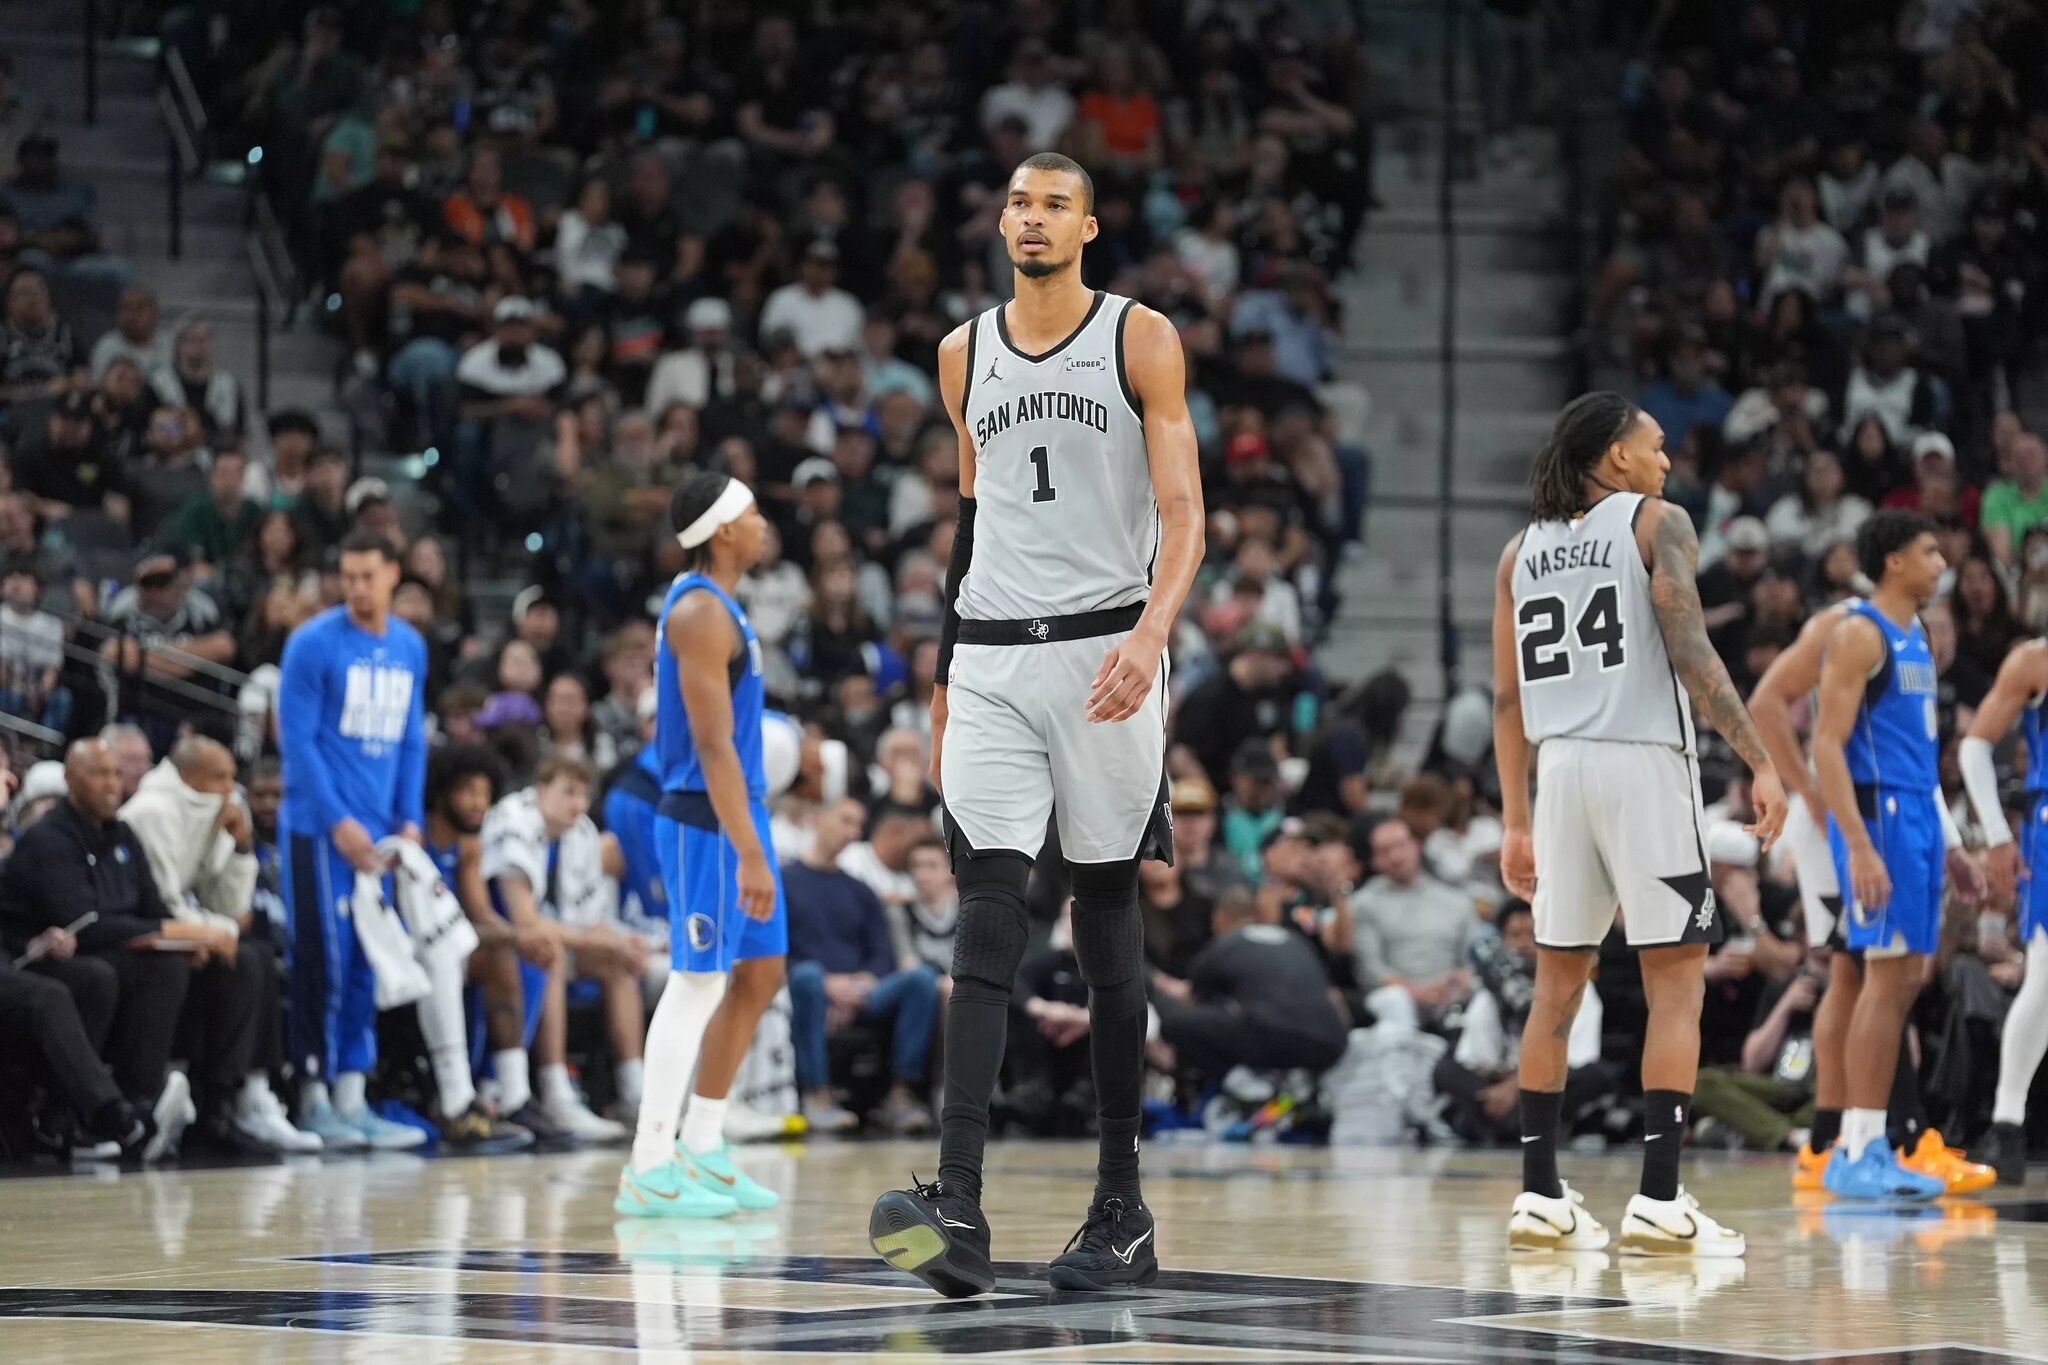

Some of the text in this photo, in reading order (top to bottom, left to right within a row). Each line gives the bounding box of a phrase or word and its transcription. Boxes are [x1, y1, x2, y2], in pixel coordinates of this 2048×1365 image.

[1071, 360, 1101, 368] LEDGER
[976, 391, 1108, 449] SAN ANTONIO
[1029, 445, 1056, 503] 1
[1525, 539, 1613, 581] VASSELL
[1517, 583, 1625, 683] 24
